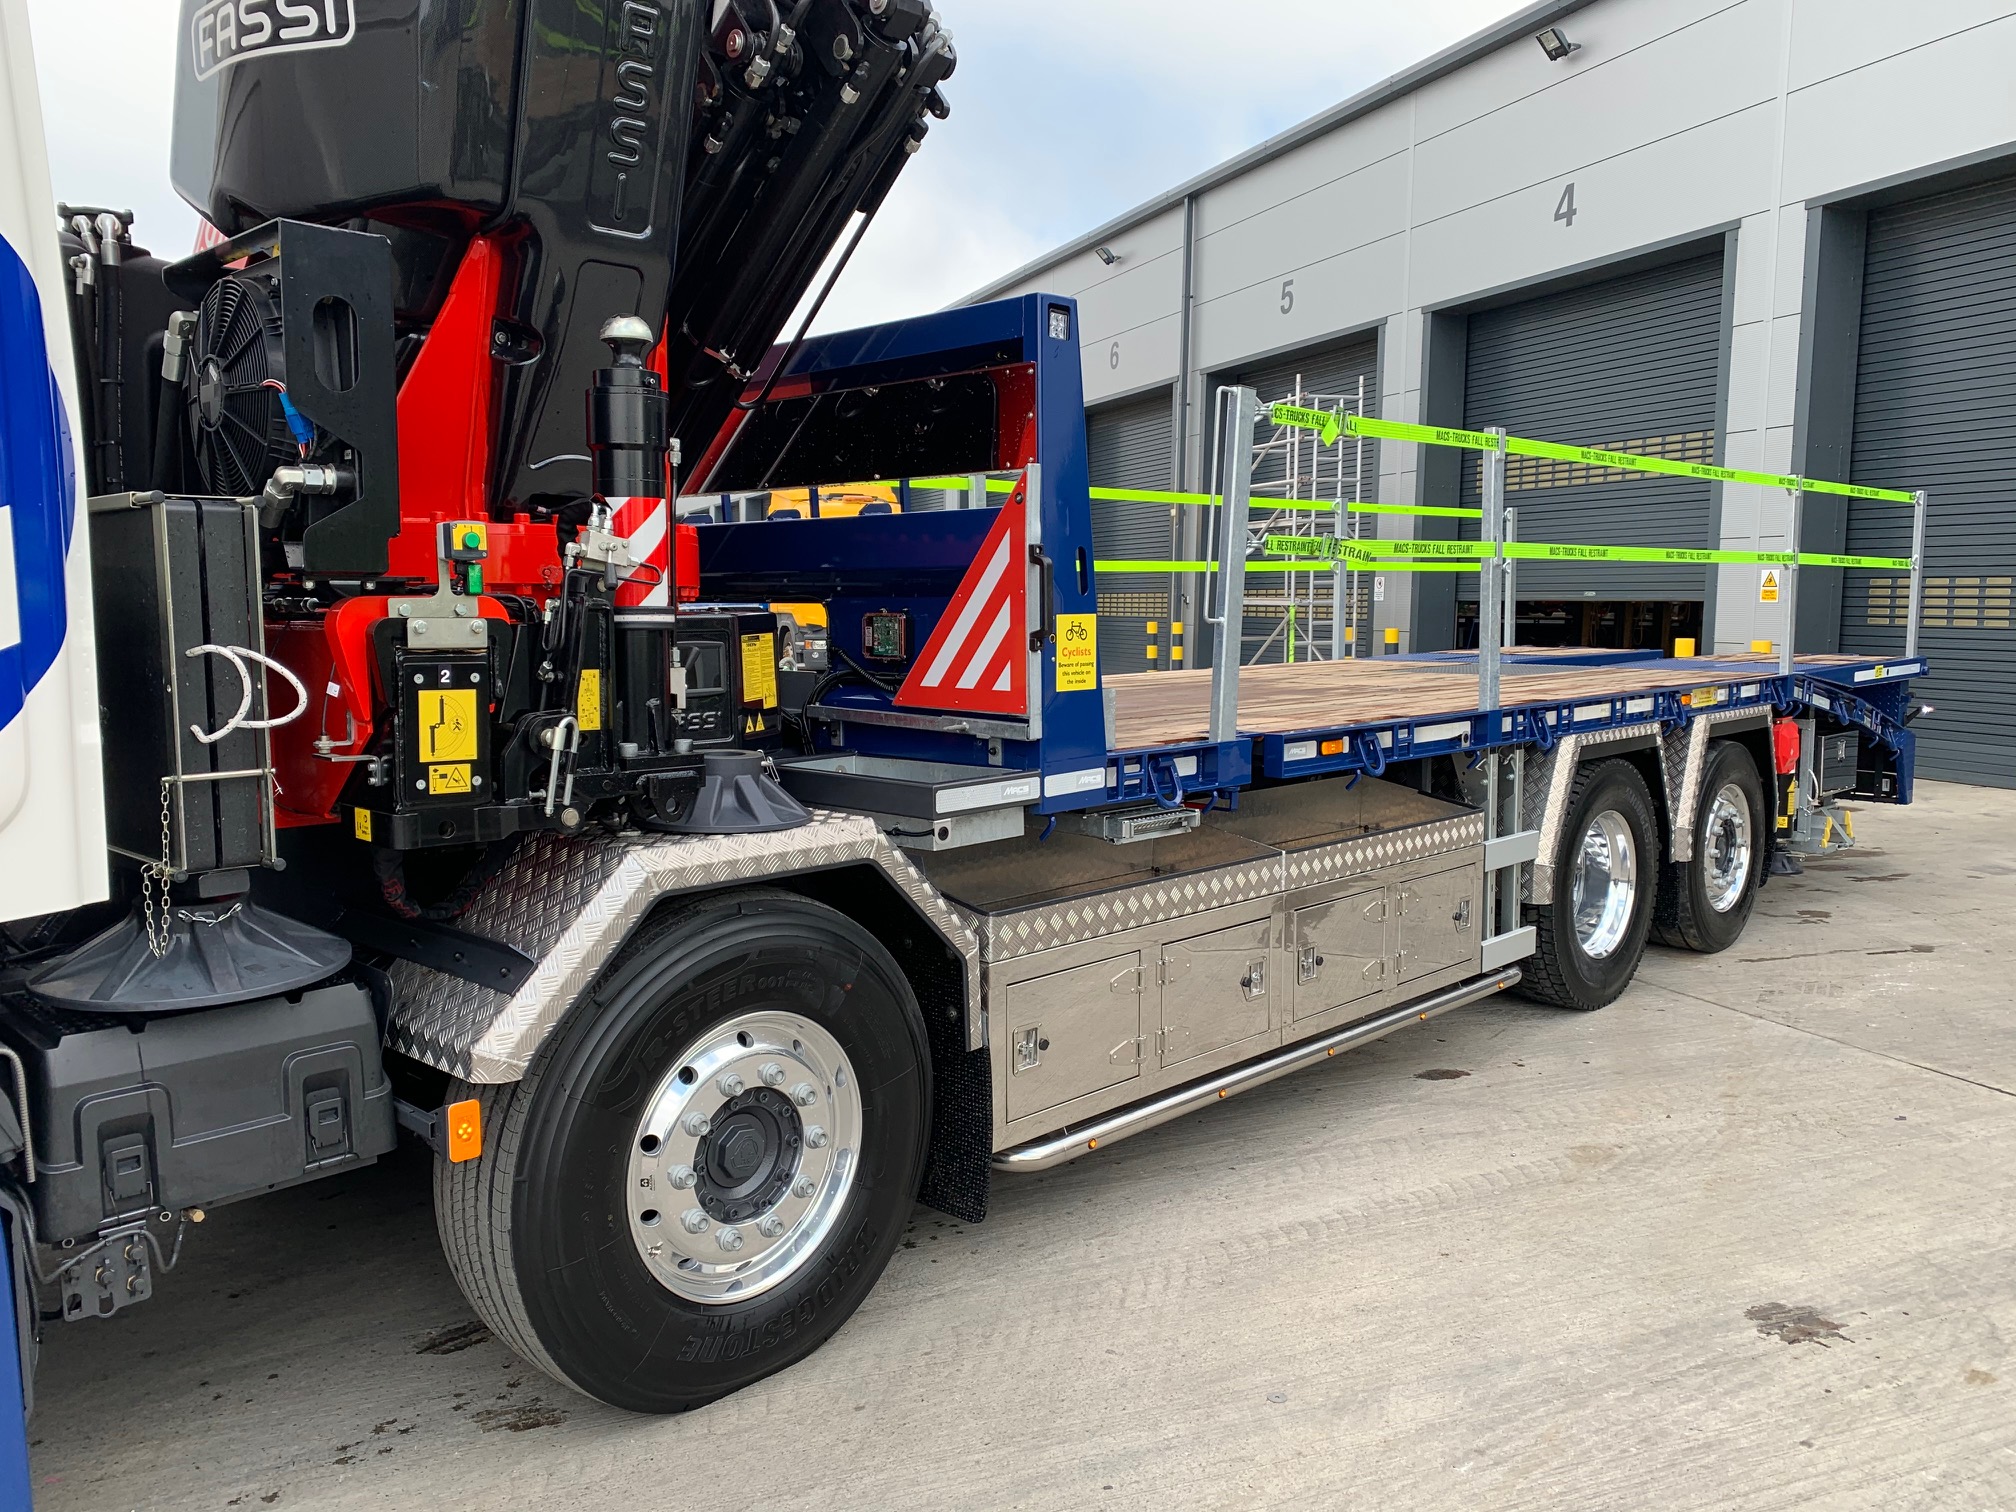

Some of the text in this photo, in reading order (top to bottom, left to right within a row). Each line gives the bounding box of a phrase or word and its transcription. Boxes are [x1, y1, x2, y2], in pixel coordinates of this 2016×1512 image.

[198, 0, 336, 68] FASSI
[1553, 182, 1577, 227] 4
[1280, 278, 1294, 315] 5
[1110, 341, 1119, 370] 6
[1436, 430, 1470, 446] MACS-TRUCKS
[1472, 434, 1483, 447] FALL
[1277, 540, 1311, 552] RESTRAINT
[1393, 543, 1474, 555] MACS-TRUCKS FALL RESTRAINT
[1061, 646, 1092, 660] Cyclists
[440, 669, 451, 683] 2
[1078, 774, 1102, 785] MACS
[1003, 784, 1030, 796] MACS
[641, 974, 756, 1072] R-STEER
[676, 1217, 878, 1363] BRIDGESTONE
